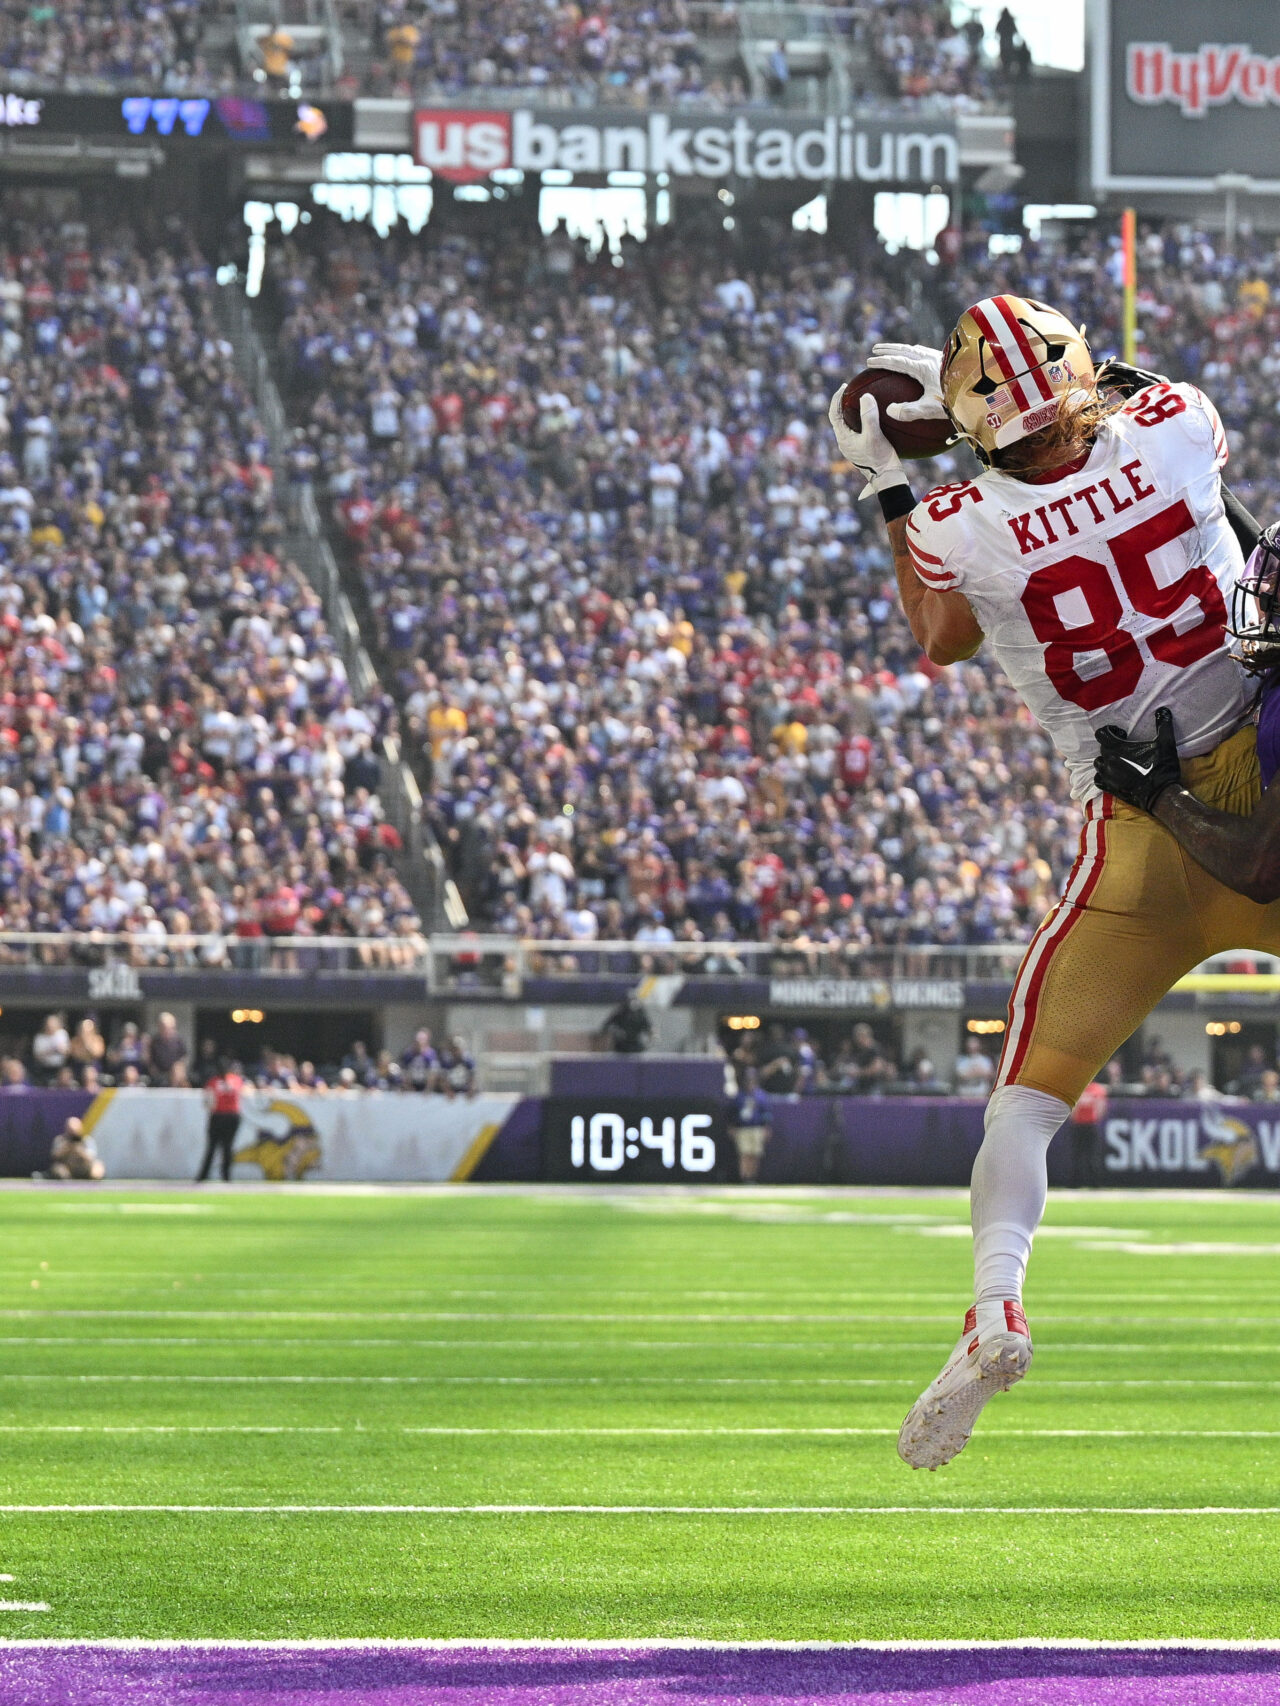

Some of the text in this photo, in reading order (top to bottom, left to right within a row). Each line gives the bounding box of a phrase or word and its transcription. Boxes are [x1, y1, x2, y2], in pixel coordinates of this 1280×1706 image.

[986, 415, 1001, 427] 37
[1121, 382, 1187, 428] 85
[1008, 459, 1156, 555] KITTLE
[1020, 500, 1228, 711] 85
[571, 1113, 716, 1172] 10:46
[1105, 1119, 1208, 1171] SKOL
